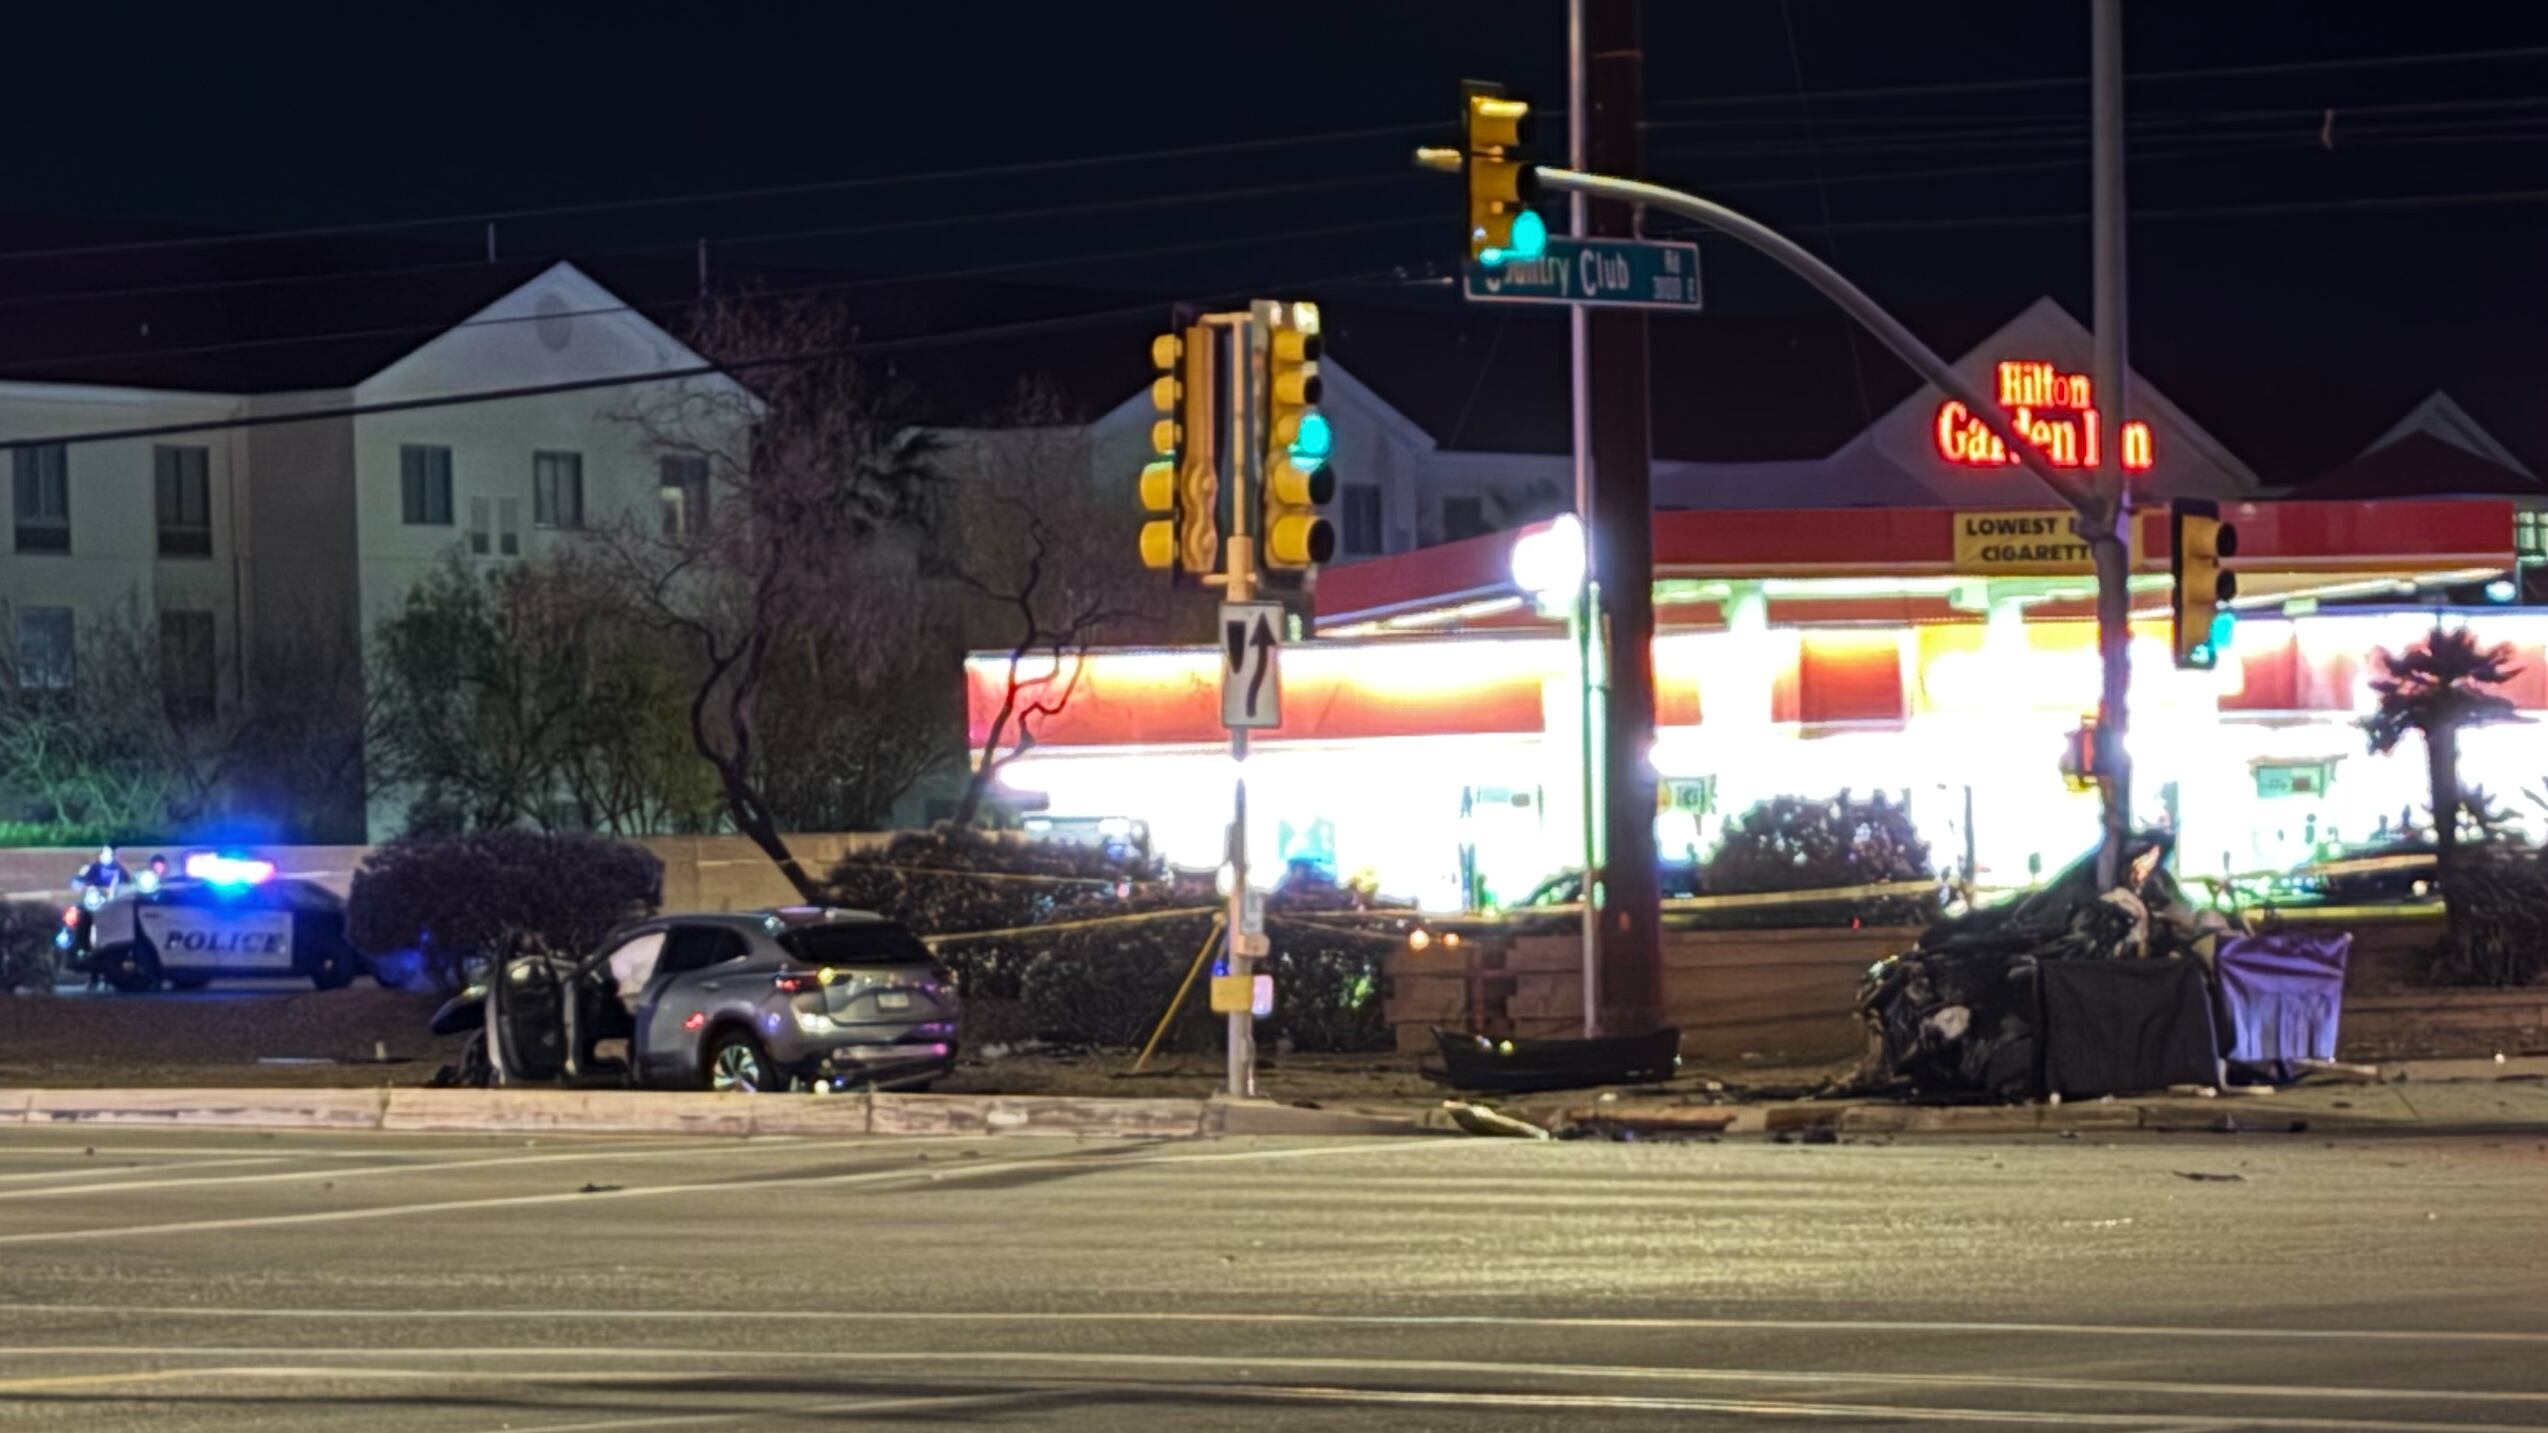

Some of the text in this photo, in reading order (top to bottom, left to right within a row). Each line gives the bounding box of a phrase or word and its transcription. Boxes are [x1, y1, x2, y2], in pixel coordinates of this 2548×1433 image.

[1579, 248, 1630, 297] Club
[1997, 360, 2092, 409] Hilton
[2082, 408, 2153, 470] In
[1965, 517, 2058, 536] LOWEST
[1981, 543, 2089, 562] CIGARETT
[164, 929, 284, 954] POLICE
